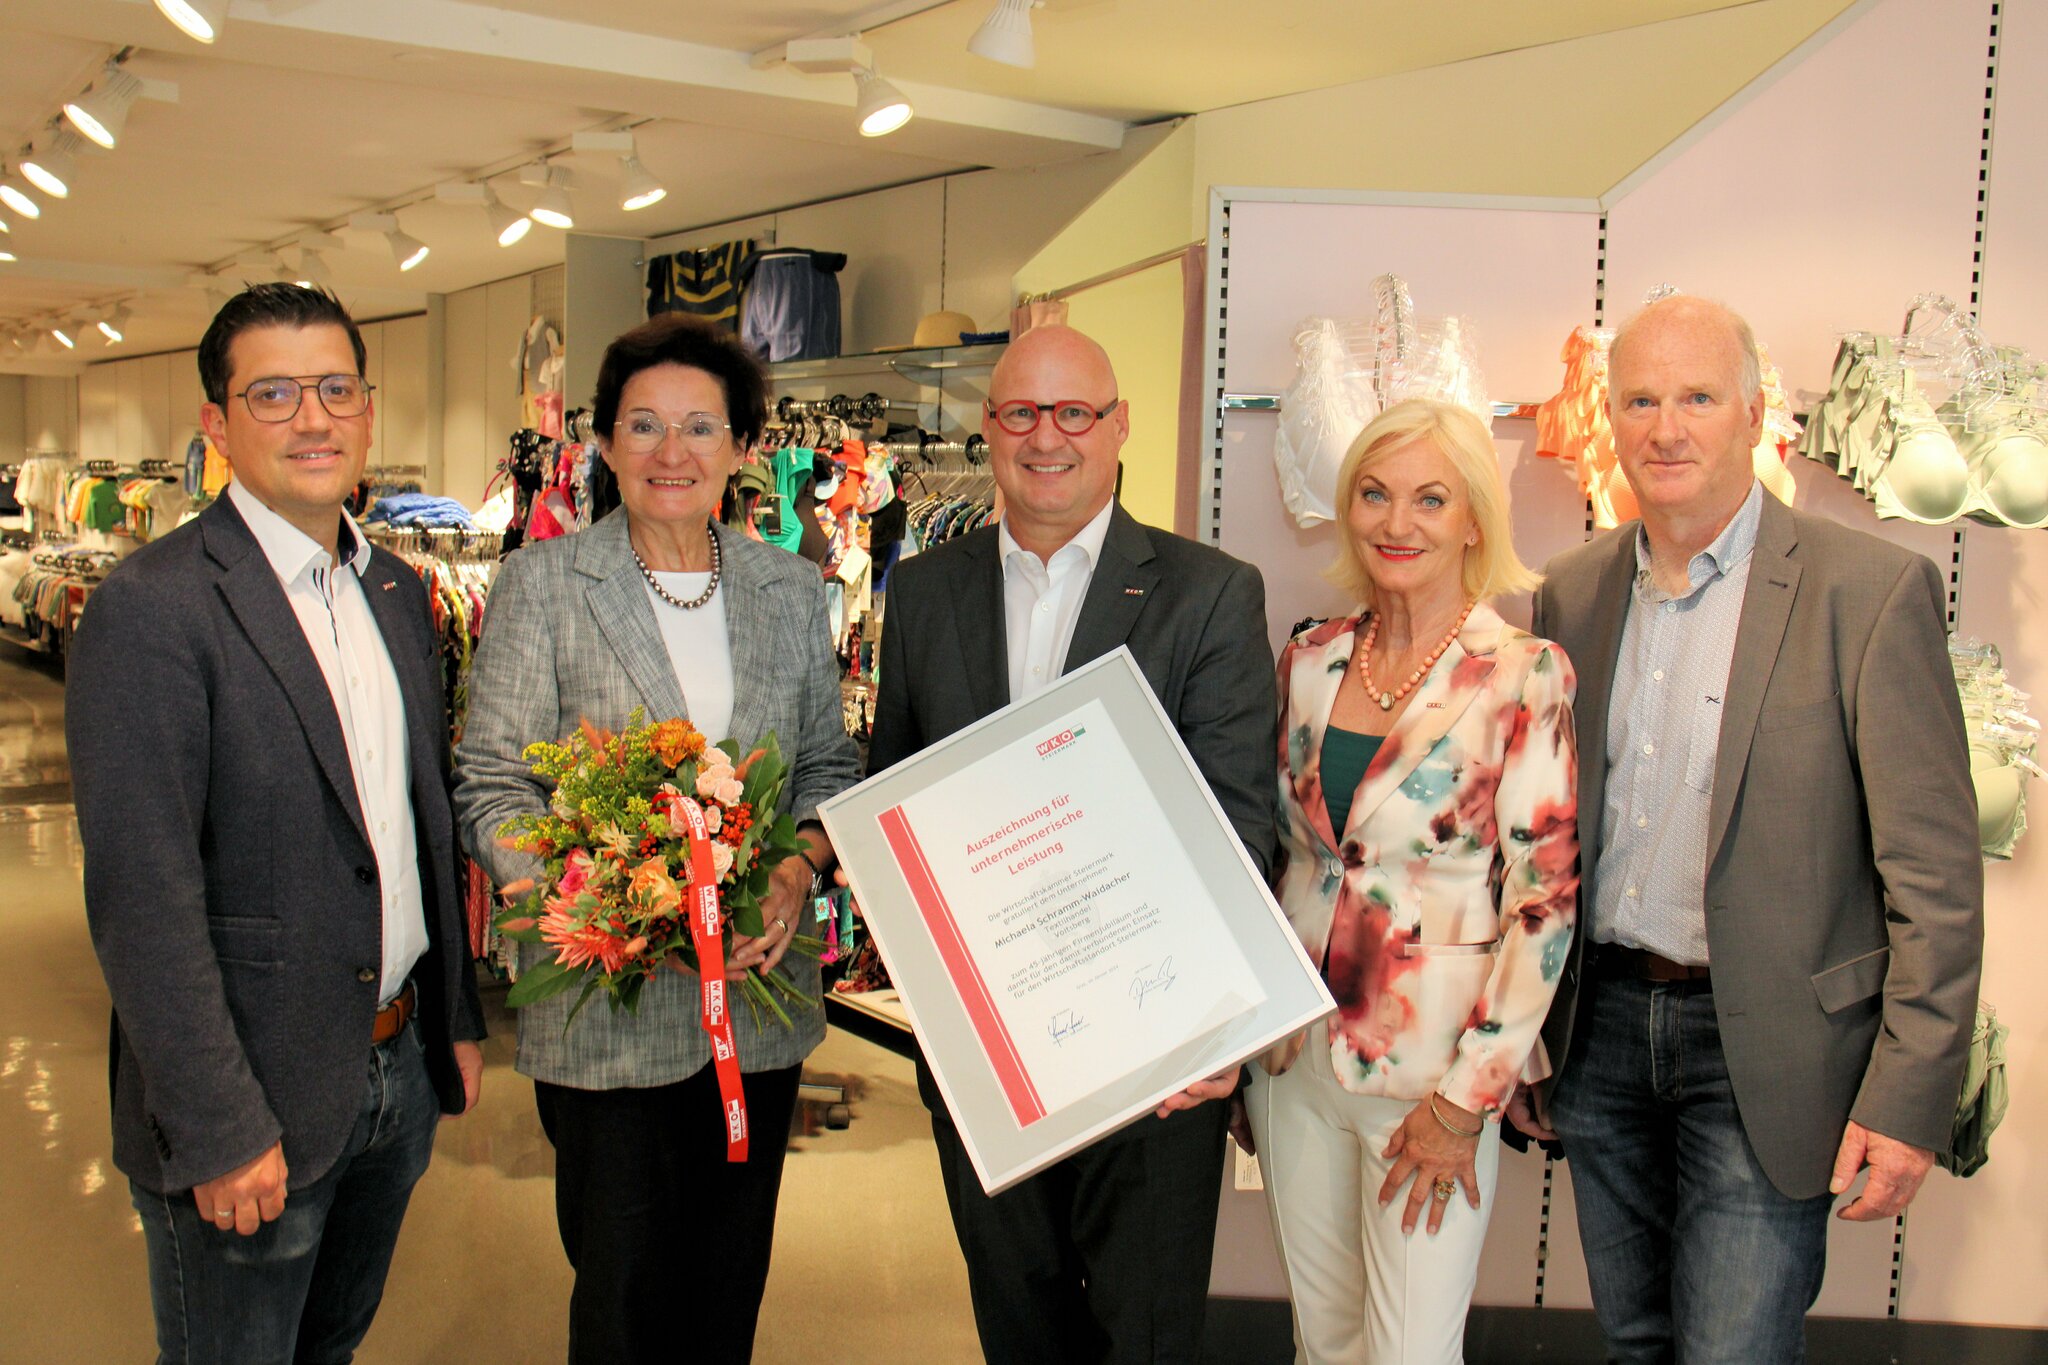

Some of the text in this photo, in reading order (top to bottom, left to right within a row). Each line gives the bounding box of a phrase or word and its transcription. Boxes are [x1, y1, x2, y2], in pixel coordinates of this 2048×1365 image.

[1036, 730, 1072, 755] WKO
[1041, 740, 1075, 760] STEIERMARK
[966, 793, 1069, 855] Auszeichnung für
[970, 809, 1083, 873] unternehmerische
[1007, 841, 1063, 875] Leistung
[705, 886, 717, 921] WKO
[987, 851, 1114, 922] Die Wirtschaftskammer Steiermark
[994, 871, 1131, 948] Michaela Schramm-Waidacher
[1002, 865, 1107, 925] gratuliert dem Unternehmen
[1043, 903, 1091, 932] Textilhandel
[1053, 916, 1090, 938] Voitsberg
[1007, 907, 1160, 992] dankt für den damit verbundenen Einsatz
[1010, 967, 1027, 980] zum
[1072, 912, 1132, 946] Firmenjubiläum
[1132, 902, 1148, 914] und
[1013, 989, 1024, 999] für
[1027, 980, 1042, 992] den
[1041, 941, 1116, 983] Wirtschaftsstandort
[712, 980, 723, 1013] WKO
[731, 1112, 741, 1142] WKO
